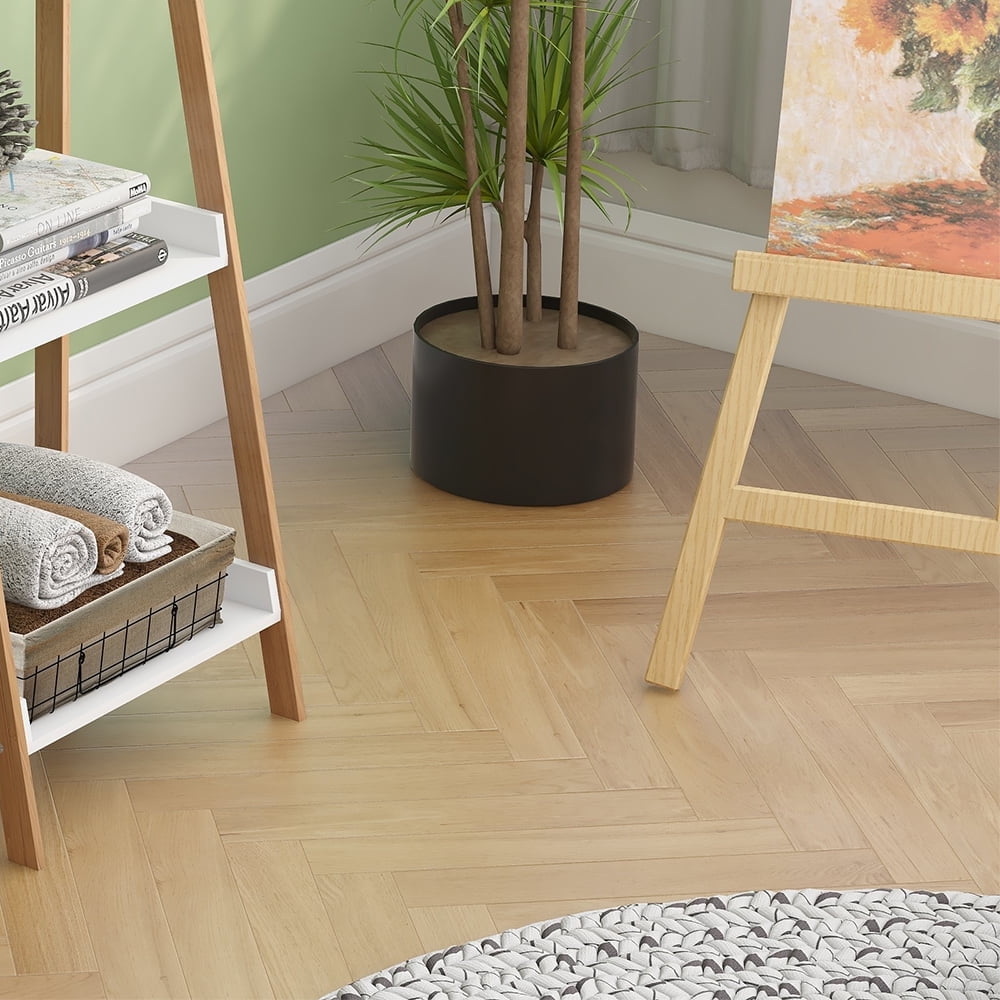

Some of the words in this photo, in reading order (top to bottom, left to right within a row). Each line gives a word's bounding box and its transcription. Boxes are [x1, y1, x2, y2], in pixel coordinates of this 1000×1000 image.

[37, 222, 53, 236] ON
[57, 207, 81, 228] LINE
[27, 240, 57, 258] Guitars
[7, 273, 55, 293] Alvar
[31, 283, 70, 320] Alvar
